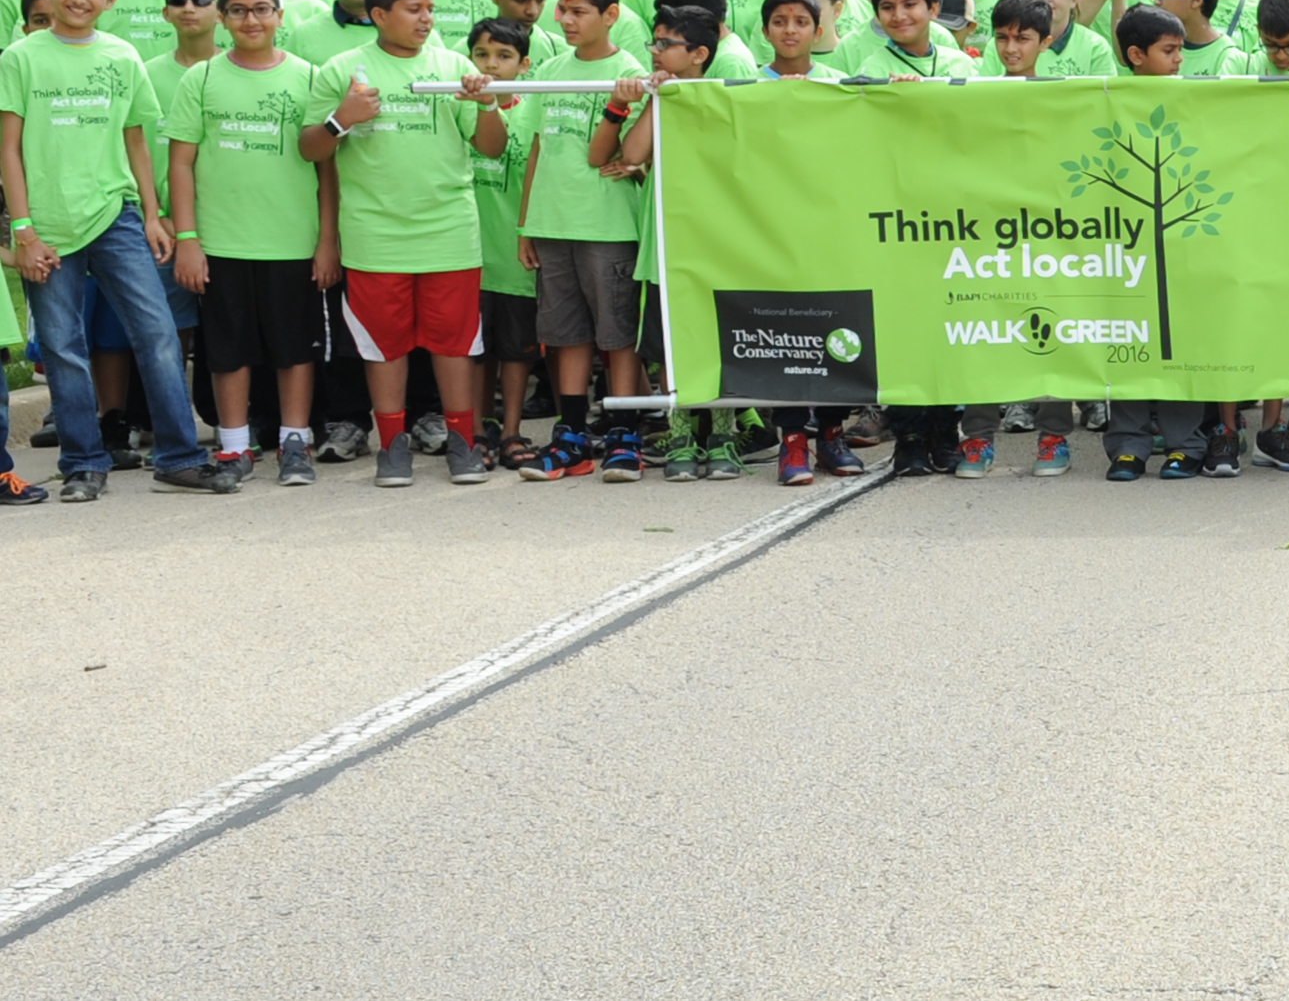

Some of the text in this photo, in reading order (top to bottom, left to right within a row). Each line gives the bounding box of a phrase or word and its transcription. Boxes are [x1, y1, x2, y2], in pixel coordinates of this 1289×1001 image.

[32, 87, 110, 99] Think Globally
[387, 93, 432, 105] Globally
[50, 97, 71, 107] Act
[379, 103, 431, 115] ct Locally
[235, 111, 280, 125] Globally
[220, 121, 280, 136] Act Locally
[405, 122, 432, 131] GREEN
[250, 142, 279, 151] GREEN
[869, 207, 1145, 249] Think globally
[943, 243, 1147, 288] Act locally
[753, 307, 833, 318] National Beneficiary
[732, 328, 824, 348] The Nature
[944, 319, 1149, 345] WALK GREEN
[732, 343, 825, 365] Conservancy
[1106, 345, 1150, 364] 2016
[784, 365, 828, 376] nature.org
[1162, 363, 1255, 373] www.bapscharities.org
